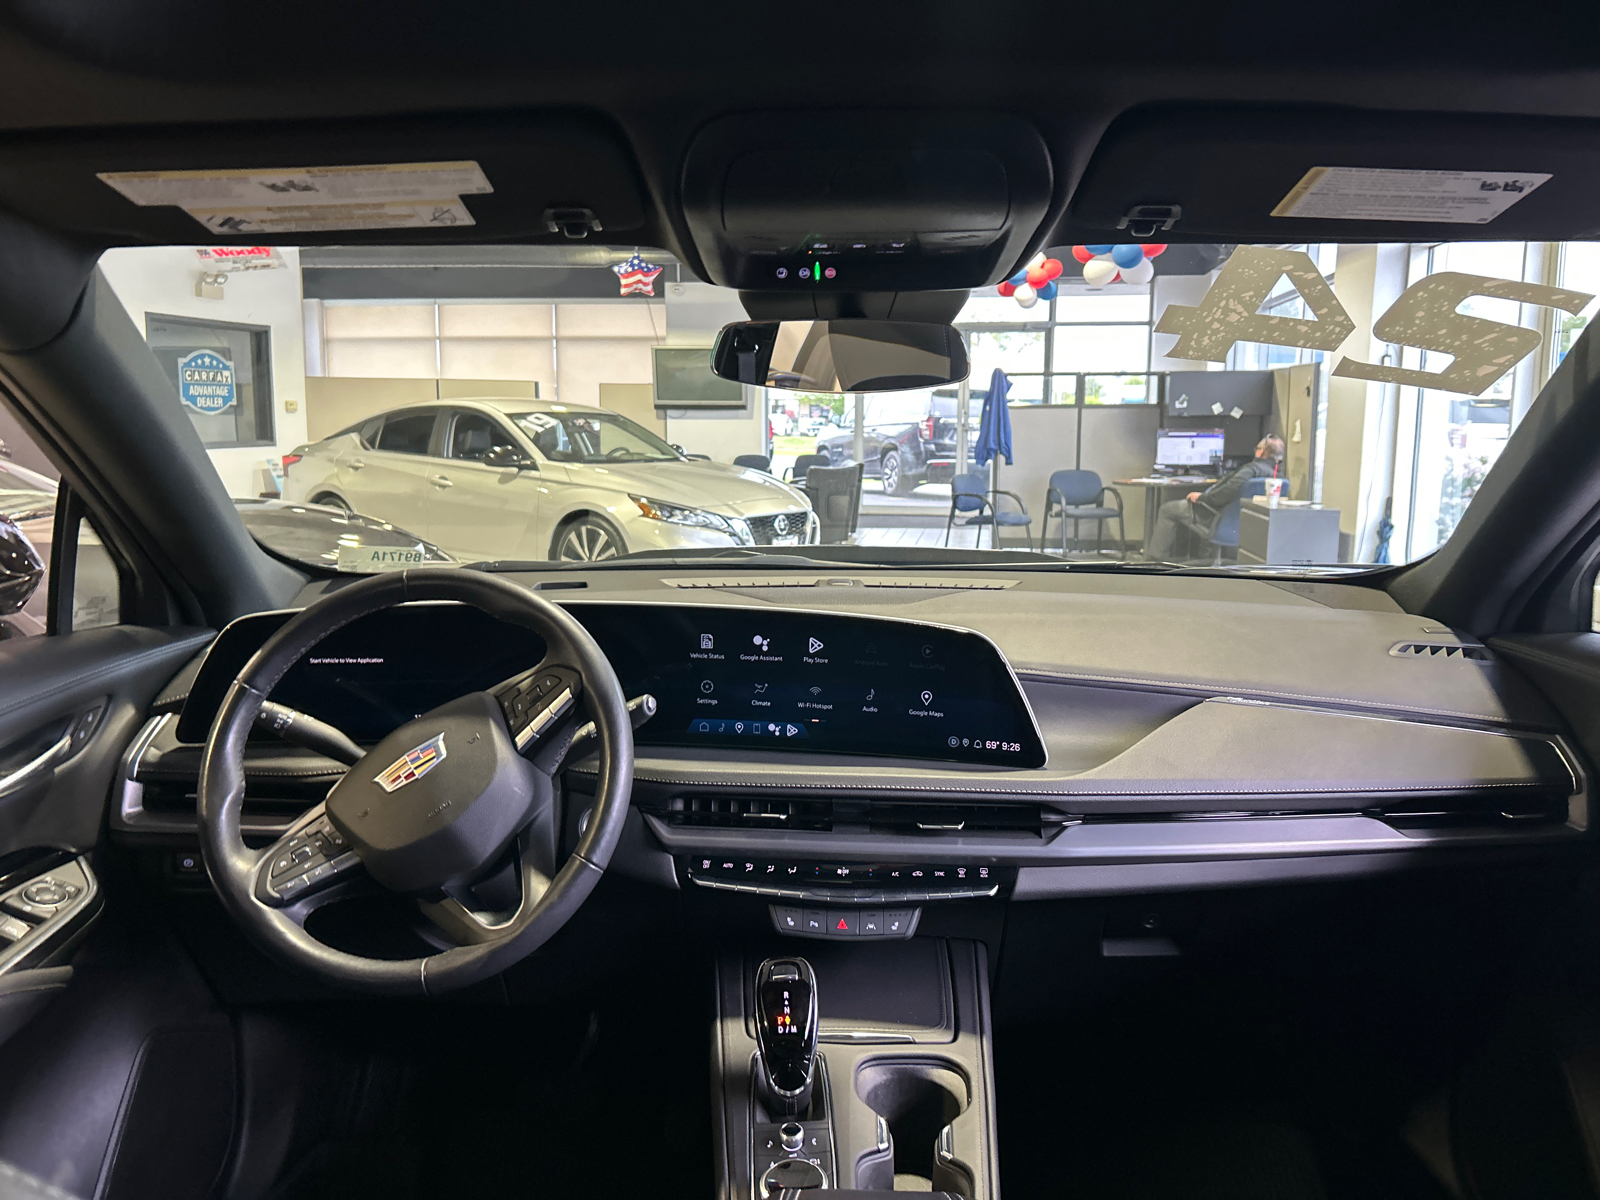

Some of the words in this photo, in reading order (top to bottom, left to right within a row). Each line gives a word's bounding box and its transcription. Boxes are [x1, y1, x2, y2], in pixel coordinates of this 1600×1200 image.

[184, 369, 231, 384] CARFAX
[189, 385, 230, 397] ADVANTAGE
[197, 396, 224, 408] DEALER
[519, 413, 559, 433] 19
[803, 656, 814, 664] Play
[696, 697, 718, 706] Settings
[751, 699, 771, 707] Climate
[812, 703, 833, 711] Hotspot
[908, 709, 928, 717] Google
[928, 710, 944, 718] Maps
[1001, 741, 1021, 752] 9:26
[783, 991, 789, 999] R
[784, 1006, 790, 1014] N
[777, 1016, 783, 1025] P
